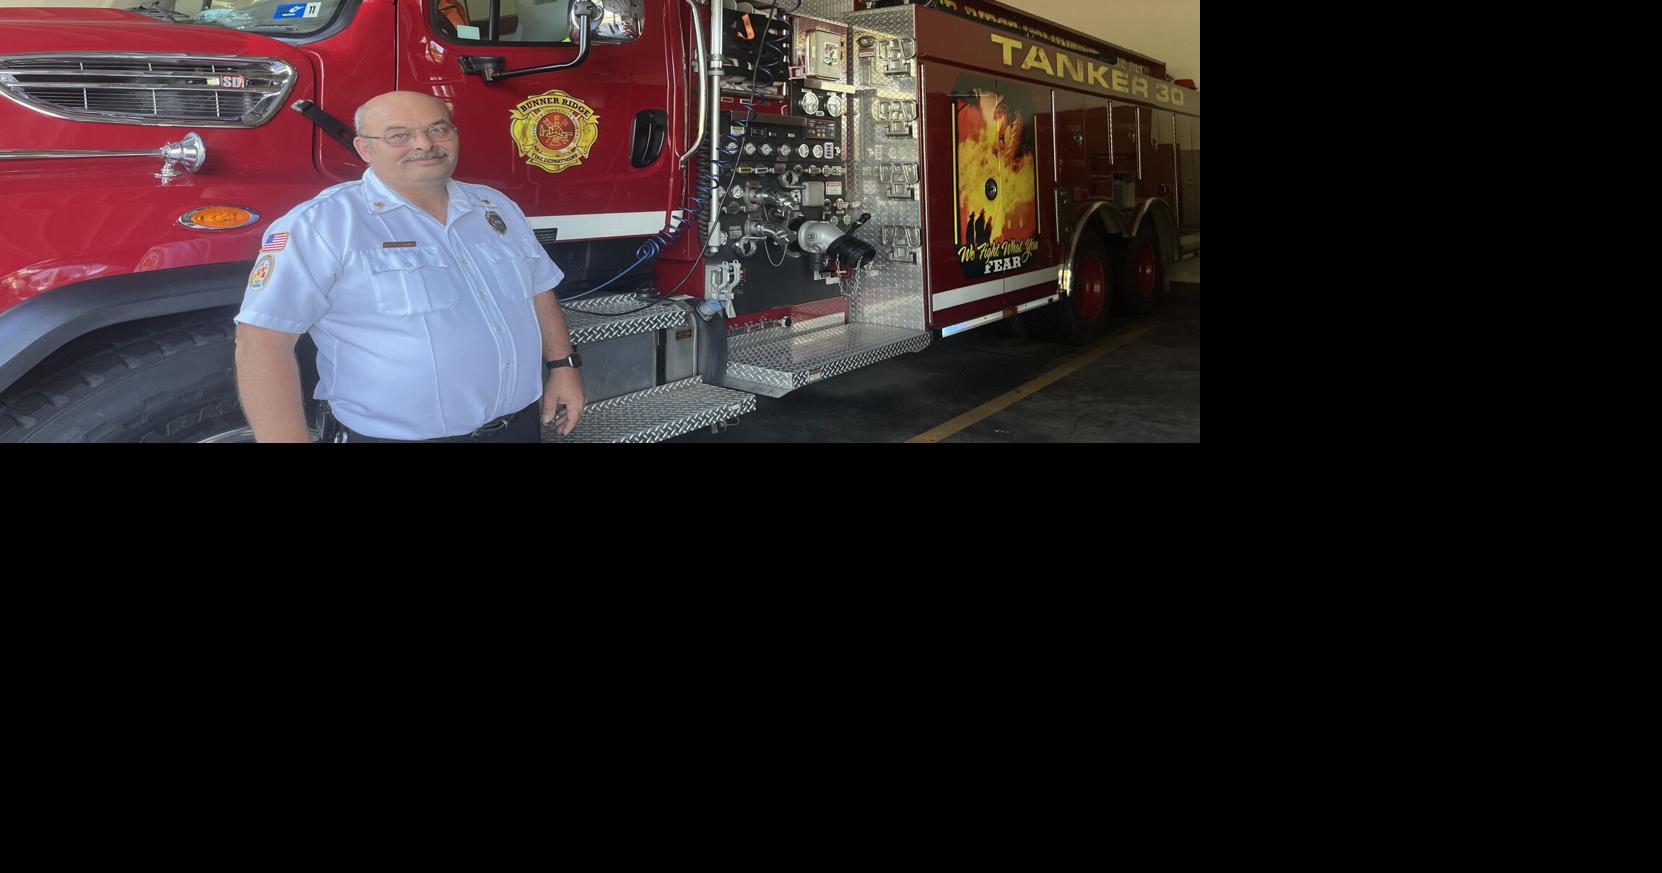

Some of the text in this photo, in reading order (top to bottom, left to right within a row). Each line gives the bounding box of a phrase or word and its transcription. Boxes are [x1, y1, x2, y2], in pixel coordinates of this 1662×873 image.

[990, 33, 1149, 99] TANKER
[1155, 83, 1185, 107] 30
[223, 75, 242, 88] SD
[520, 97, 591, 117] BUNNER RIDGE
[543, 153, 578, 164] DEPARTMENT
[957, 238, 1039, 264] We Fight What You
[984, 255, 1022, 275] FEAR
